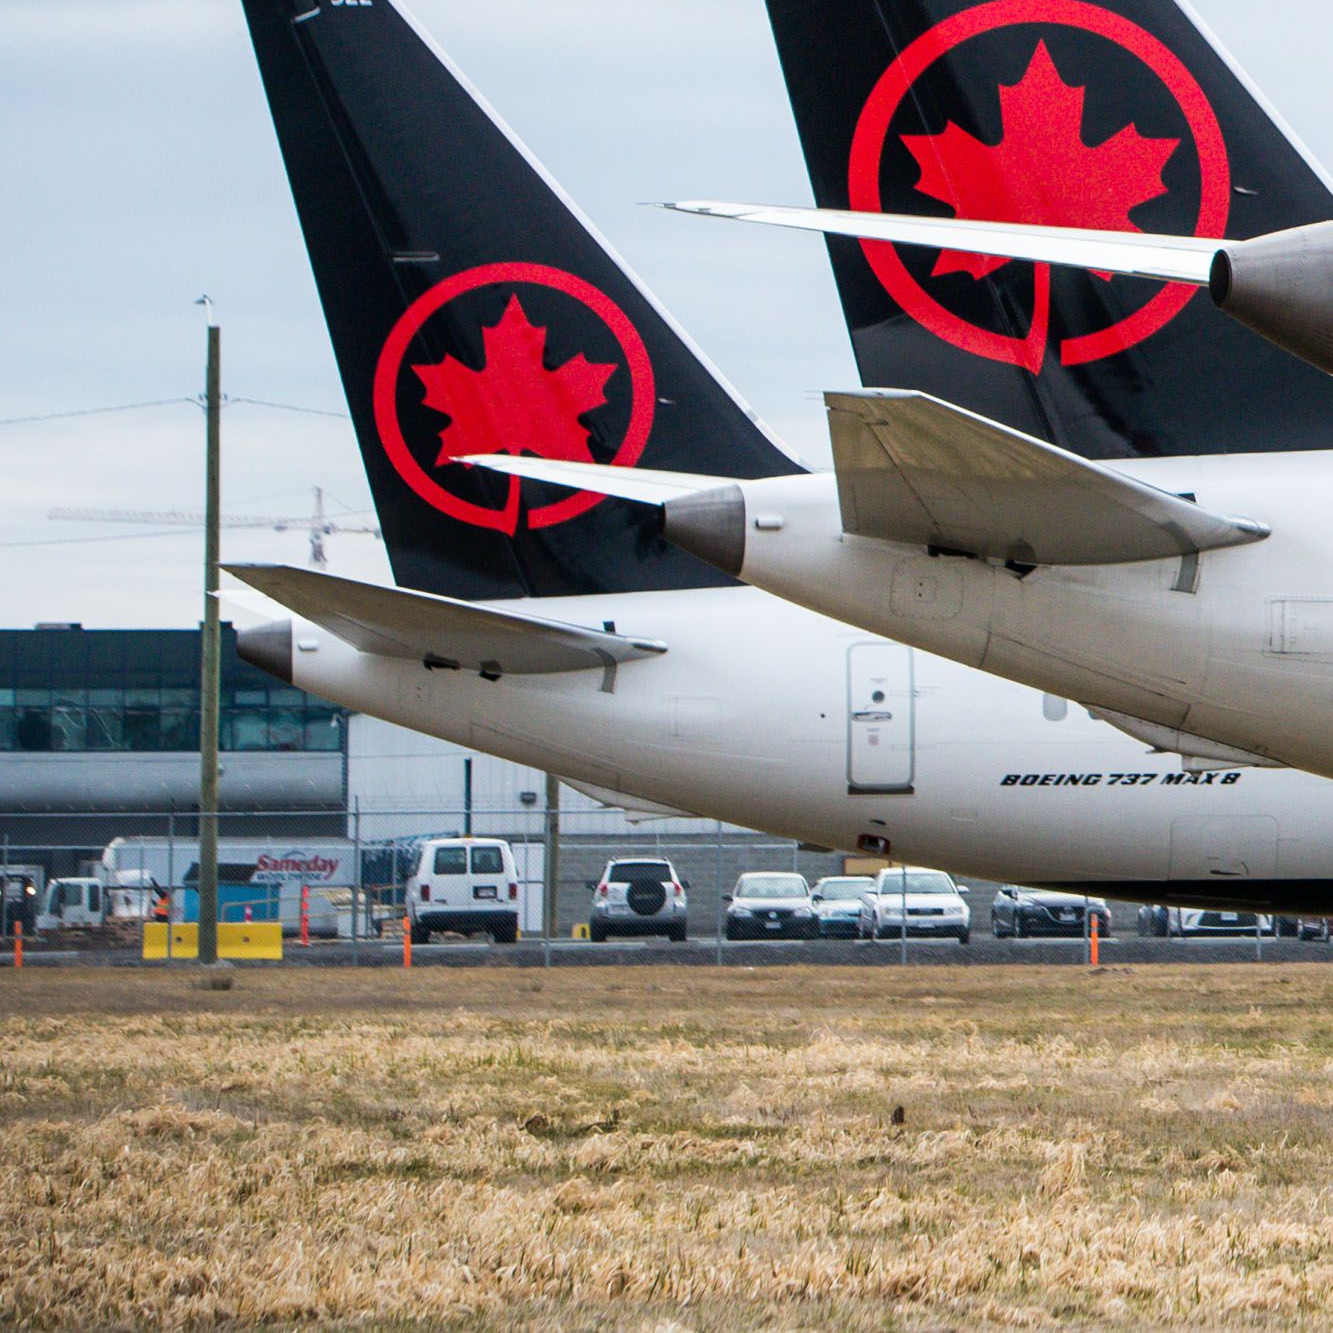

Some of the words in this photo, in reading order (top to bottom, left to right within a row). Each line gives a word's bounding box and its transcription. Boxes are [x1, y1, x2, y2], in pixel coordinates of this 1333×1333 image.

[1000, 773, 1102, 786] BOEING
[1107, 773, 1158, 785] 737
[1160, 772, 1219, 785] MAX
[1220, 772, 1241, 785] 8
